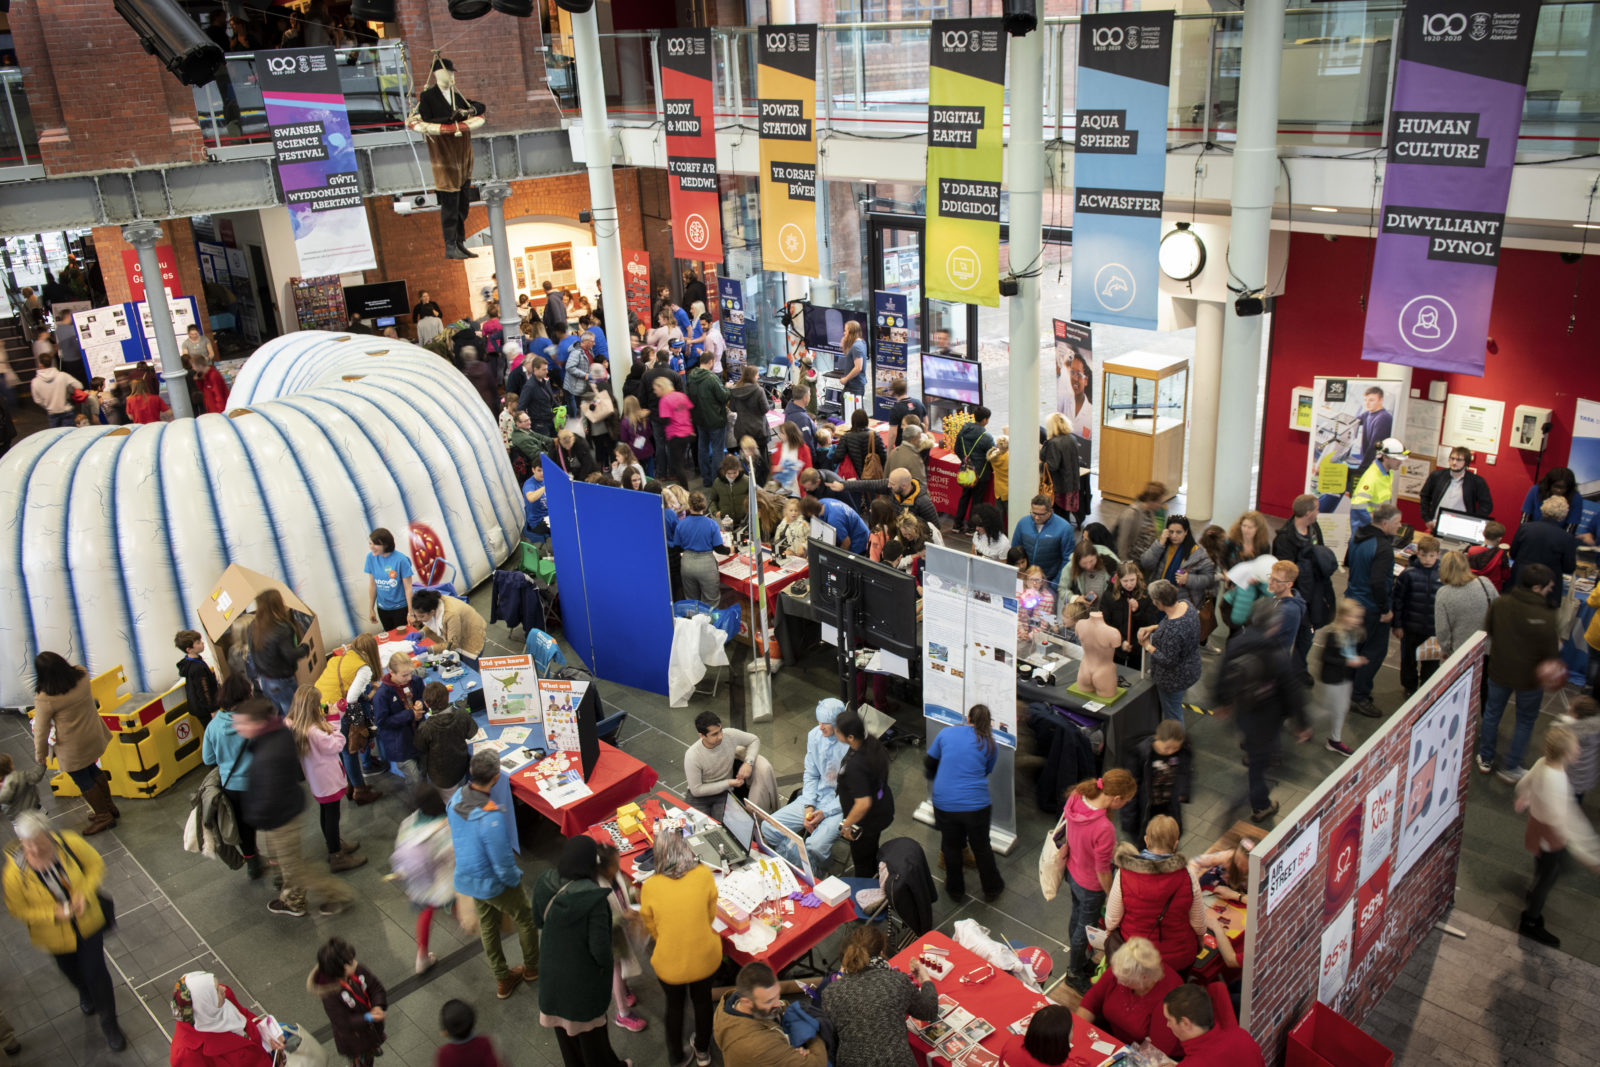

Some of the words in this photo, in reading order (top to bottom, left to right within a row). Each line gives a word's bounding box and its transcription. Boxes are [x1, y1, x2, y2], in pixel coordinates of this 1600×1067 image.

[1422, 12, 1467, 36] 100
[766, 33, 787, 48] 100
[941, 30, 968, 48] 100
[1092, 27, 1124, 46] 100
[667, 37, 685, 52] 100
[267, 56, 296, 72] 100
[667, 103, 691, 115] BODY
[762, 104, 800, 117] POWER
[933, 111, 981, 124] DIGITAL
[1080, 115, 1119, 129] AQUA
[274, 124, 322, 138] SWANSEA
[667, 121, 674, 131] &
[675, 121, 699, 132] MIND
[762, 122, 807, 135] STATION
[1397, 118, 1471, 135] HUMAN
[276, 137, 319, 149] SCIENCE
[933, 129, 972, 143] EARTH
[1080, 134, 1130, 148] SPHERE
[279, 148, 325, 161] FESTIVAL
[1395, 141, 1480, 159] CULTURE
[669, 161, 676, 172] Y
[676, 162, 700, 173] CORFF
[702, 162, 715, 174] A'R
[772, 167, 784, 178] YR
[786, 168, 815, 181] ORSAF
[329, 174, 356, 185] GŴYL
[681, 177, 717, 189] MEDDWL
[288, 185, 359, 202] WYDDONIAETH
[790, 182, 815, 196] BŴER
[941, 182, 951, 194] Y
[951, 183, 998, 198] DDAEAR
[312, 196, 361, 210] ABERTAWE
[942, 200, 998, 216] DDIGIDOL
[1078, 194, 1161, 211] ACWASFFER
[1386, 213, 1500, 235] DIWYLLIANT
[1433, 238, 1495, 257] DYNOL
[480, 659, 493, 667] Did
[507, 657, 525, 665] know
[1270, 857, 1298, 897] STREET
[1297, 841, 1312, 867] BHF
[1272, 859, 1284, 880] AIR
[1360, 888, 1384, 928] 58%
[1323, 935, 1348, 976] 95%
